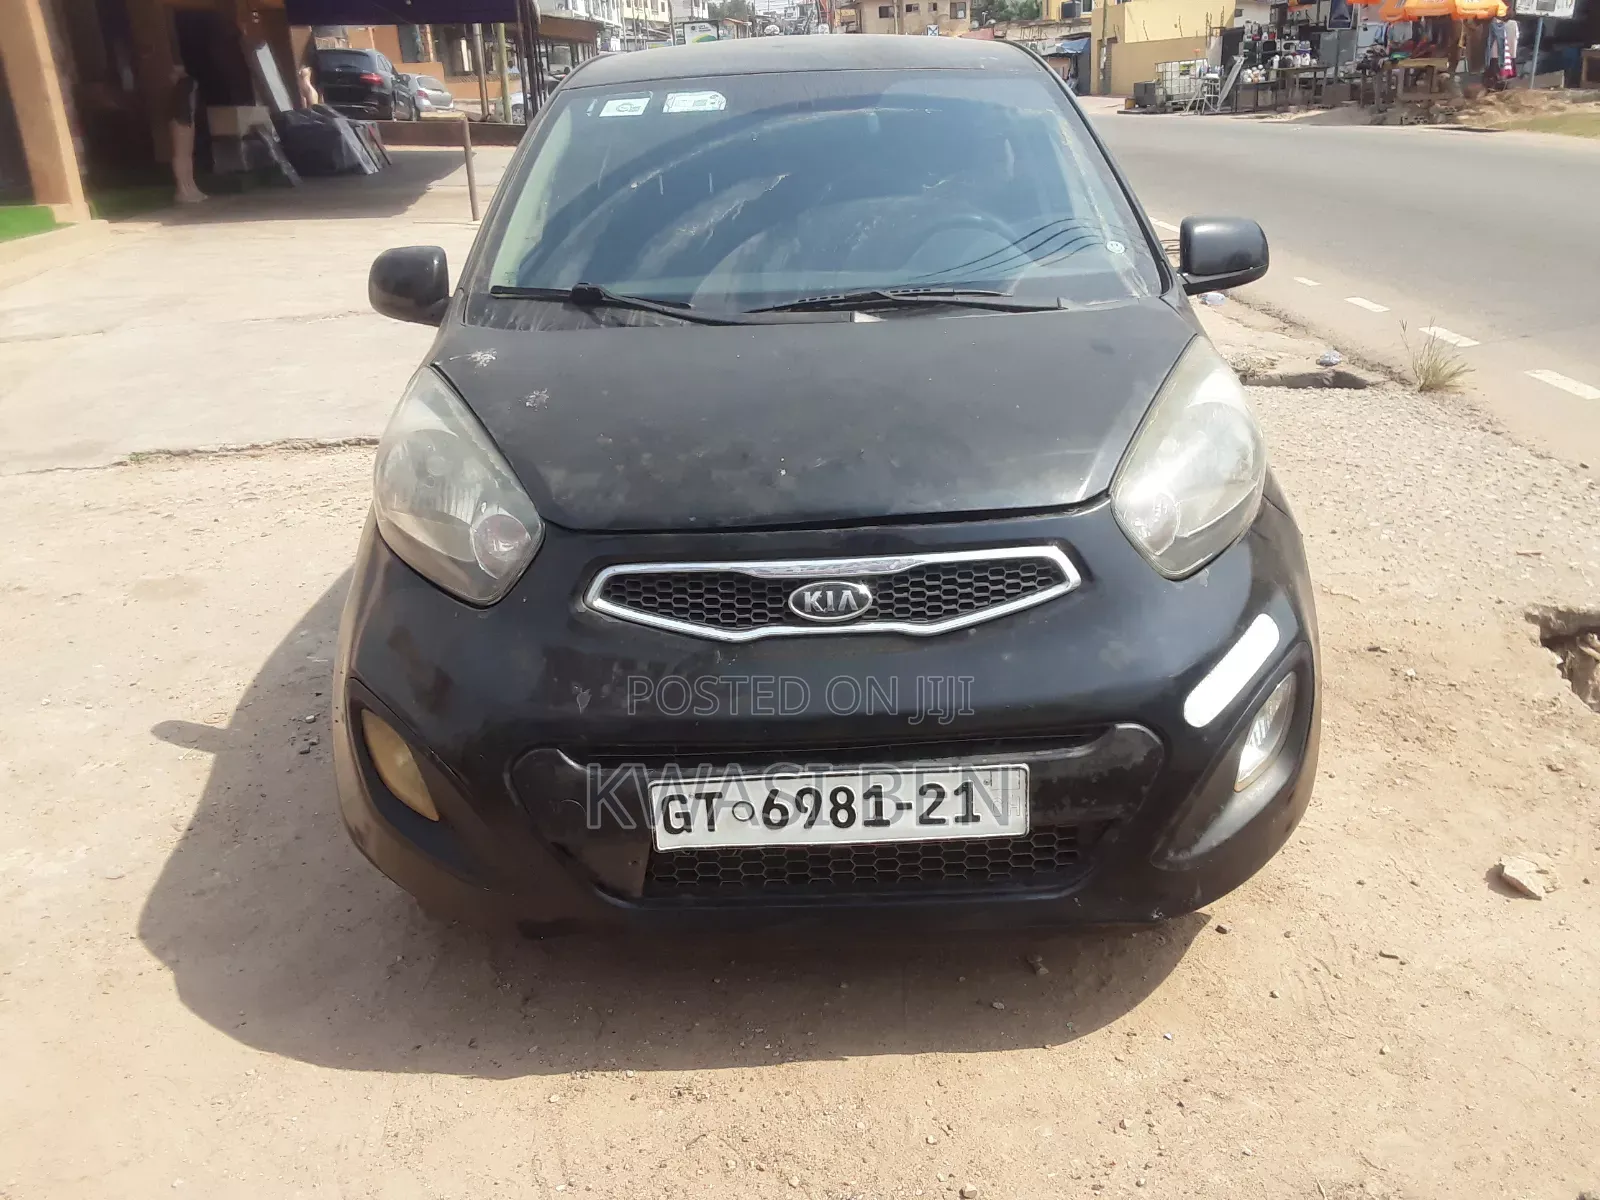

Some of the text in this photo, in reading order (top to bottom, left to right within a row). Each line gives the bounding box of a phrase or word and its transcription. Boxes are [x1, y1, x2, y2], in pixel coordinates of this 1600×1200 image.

[803, 590, 858, 612] KIA
[661, 781, 982, 835] GT 6981-21
